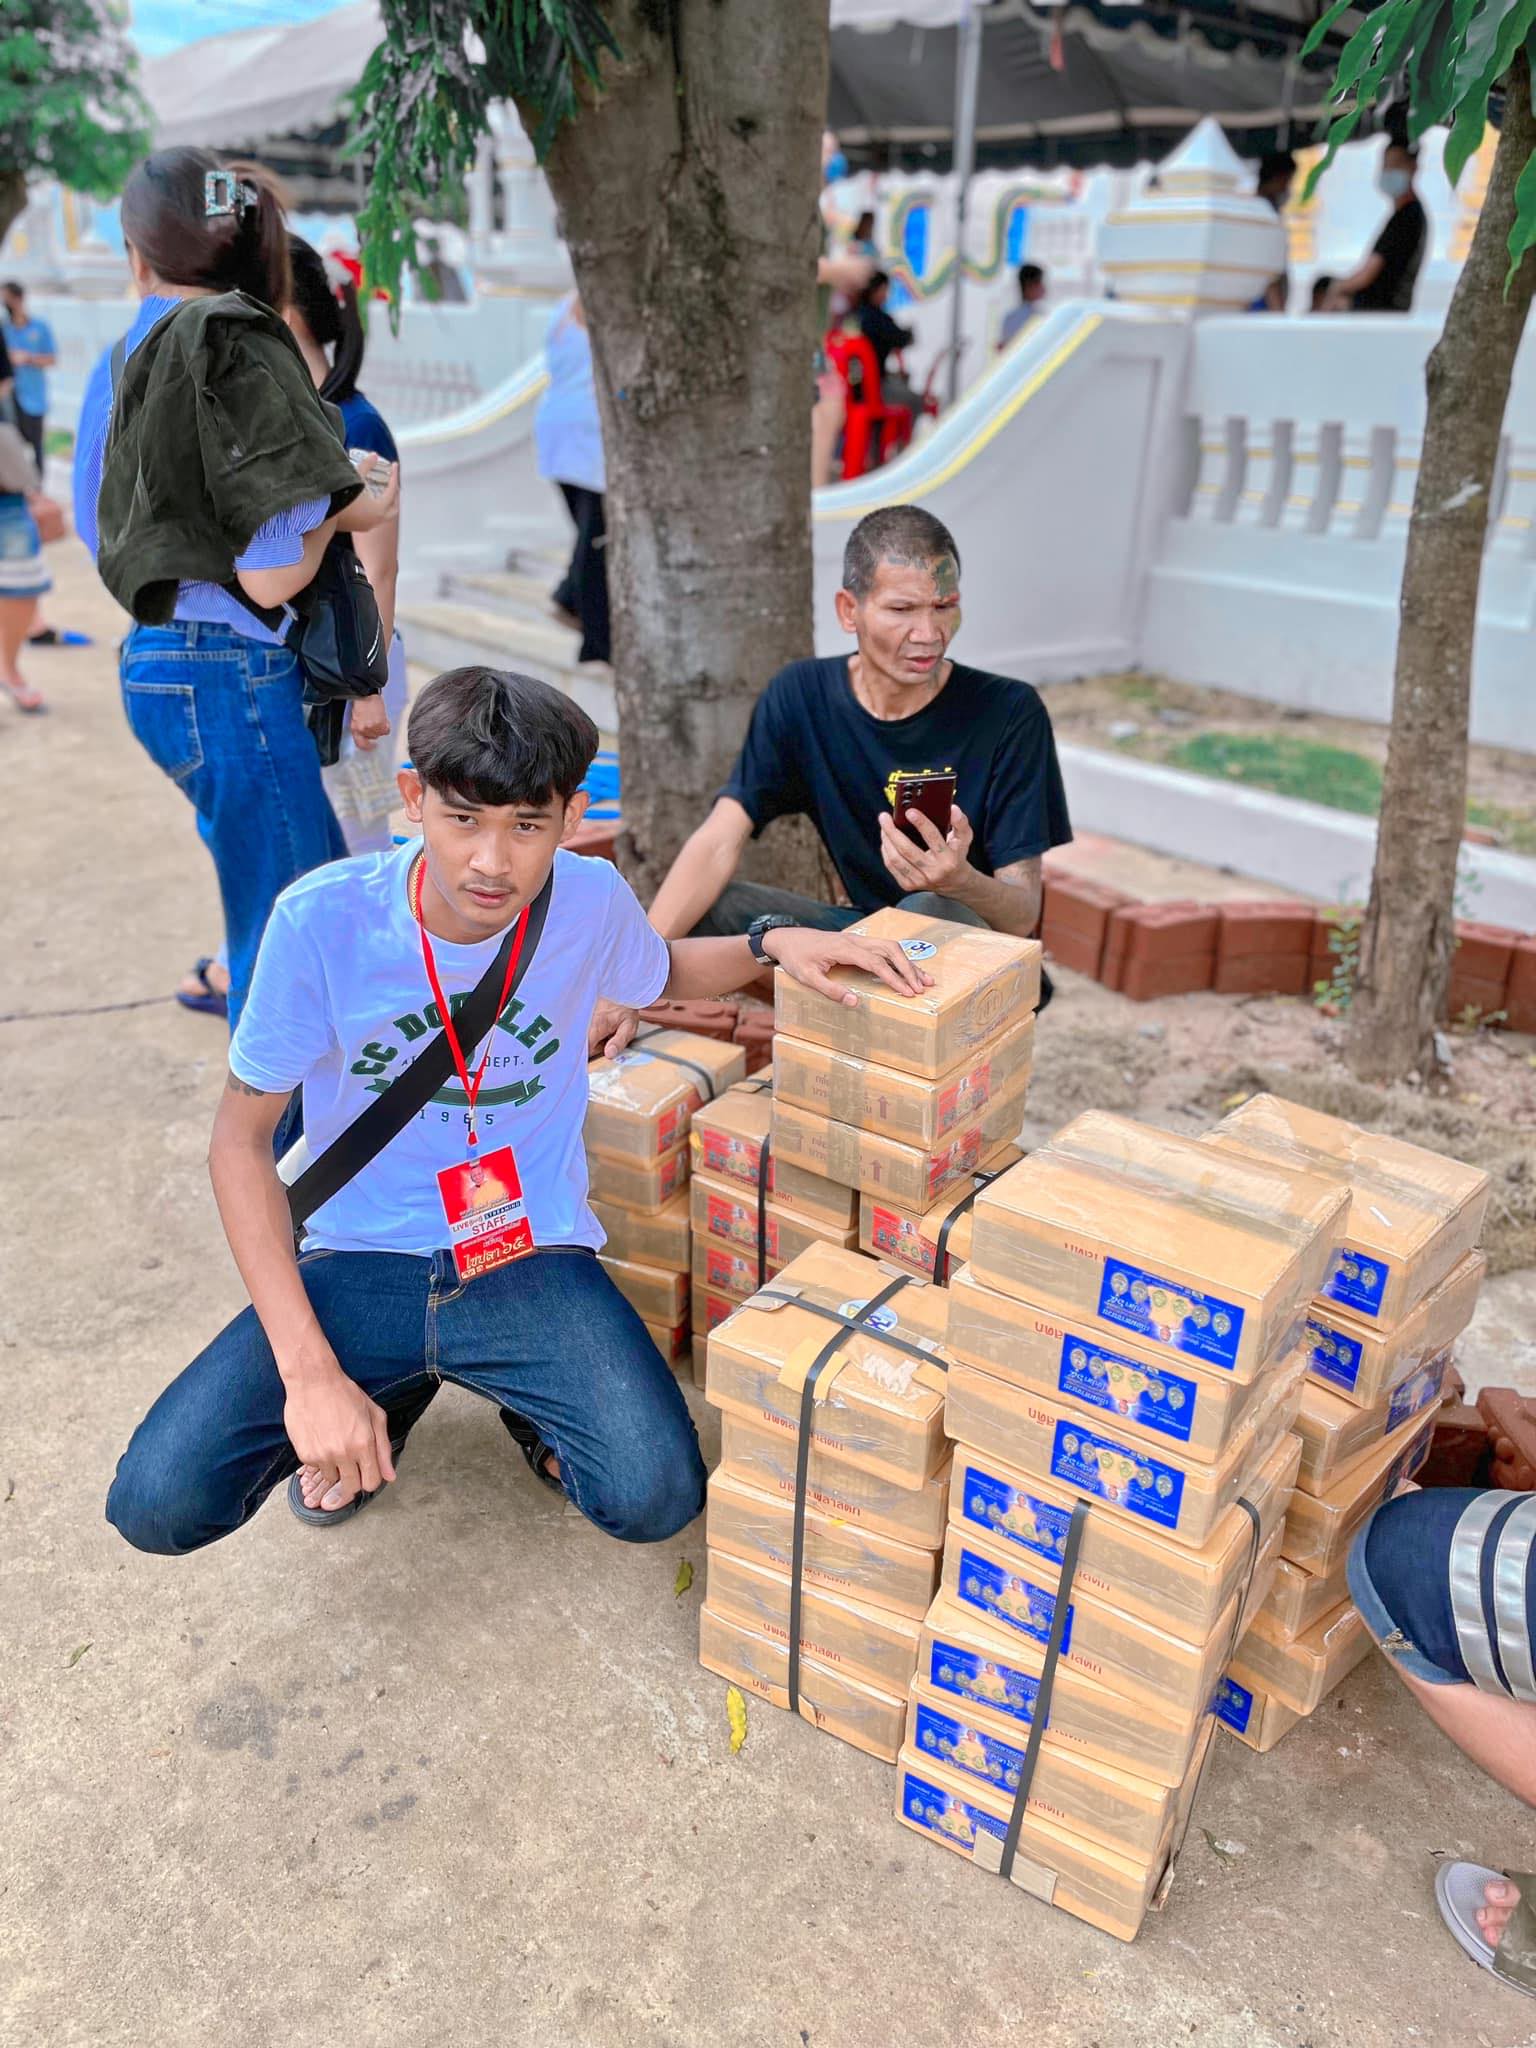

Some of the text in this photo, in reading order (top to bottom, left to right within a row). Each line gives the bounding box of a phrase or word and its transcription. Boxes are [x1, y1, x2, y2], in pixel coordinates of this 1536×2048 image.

[350, 1042, 398, 1075] CC
[393, 991, 553, 1049] DOLE
[452, 1221, 469, 1233] LIVE
[472, 1214, 507, 1235] STAFF
